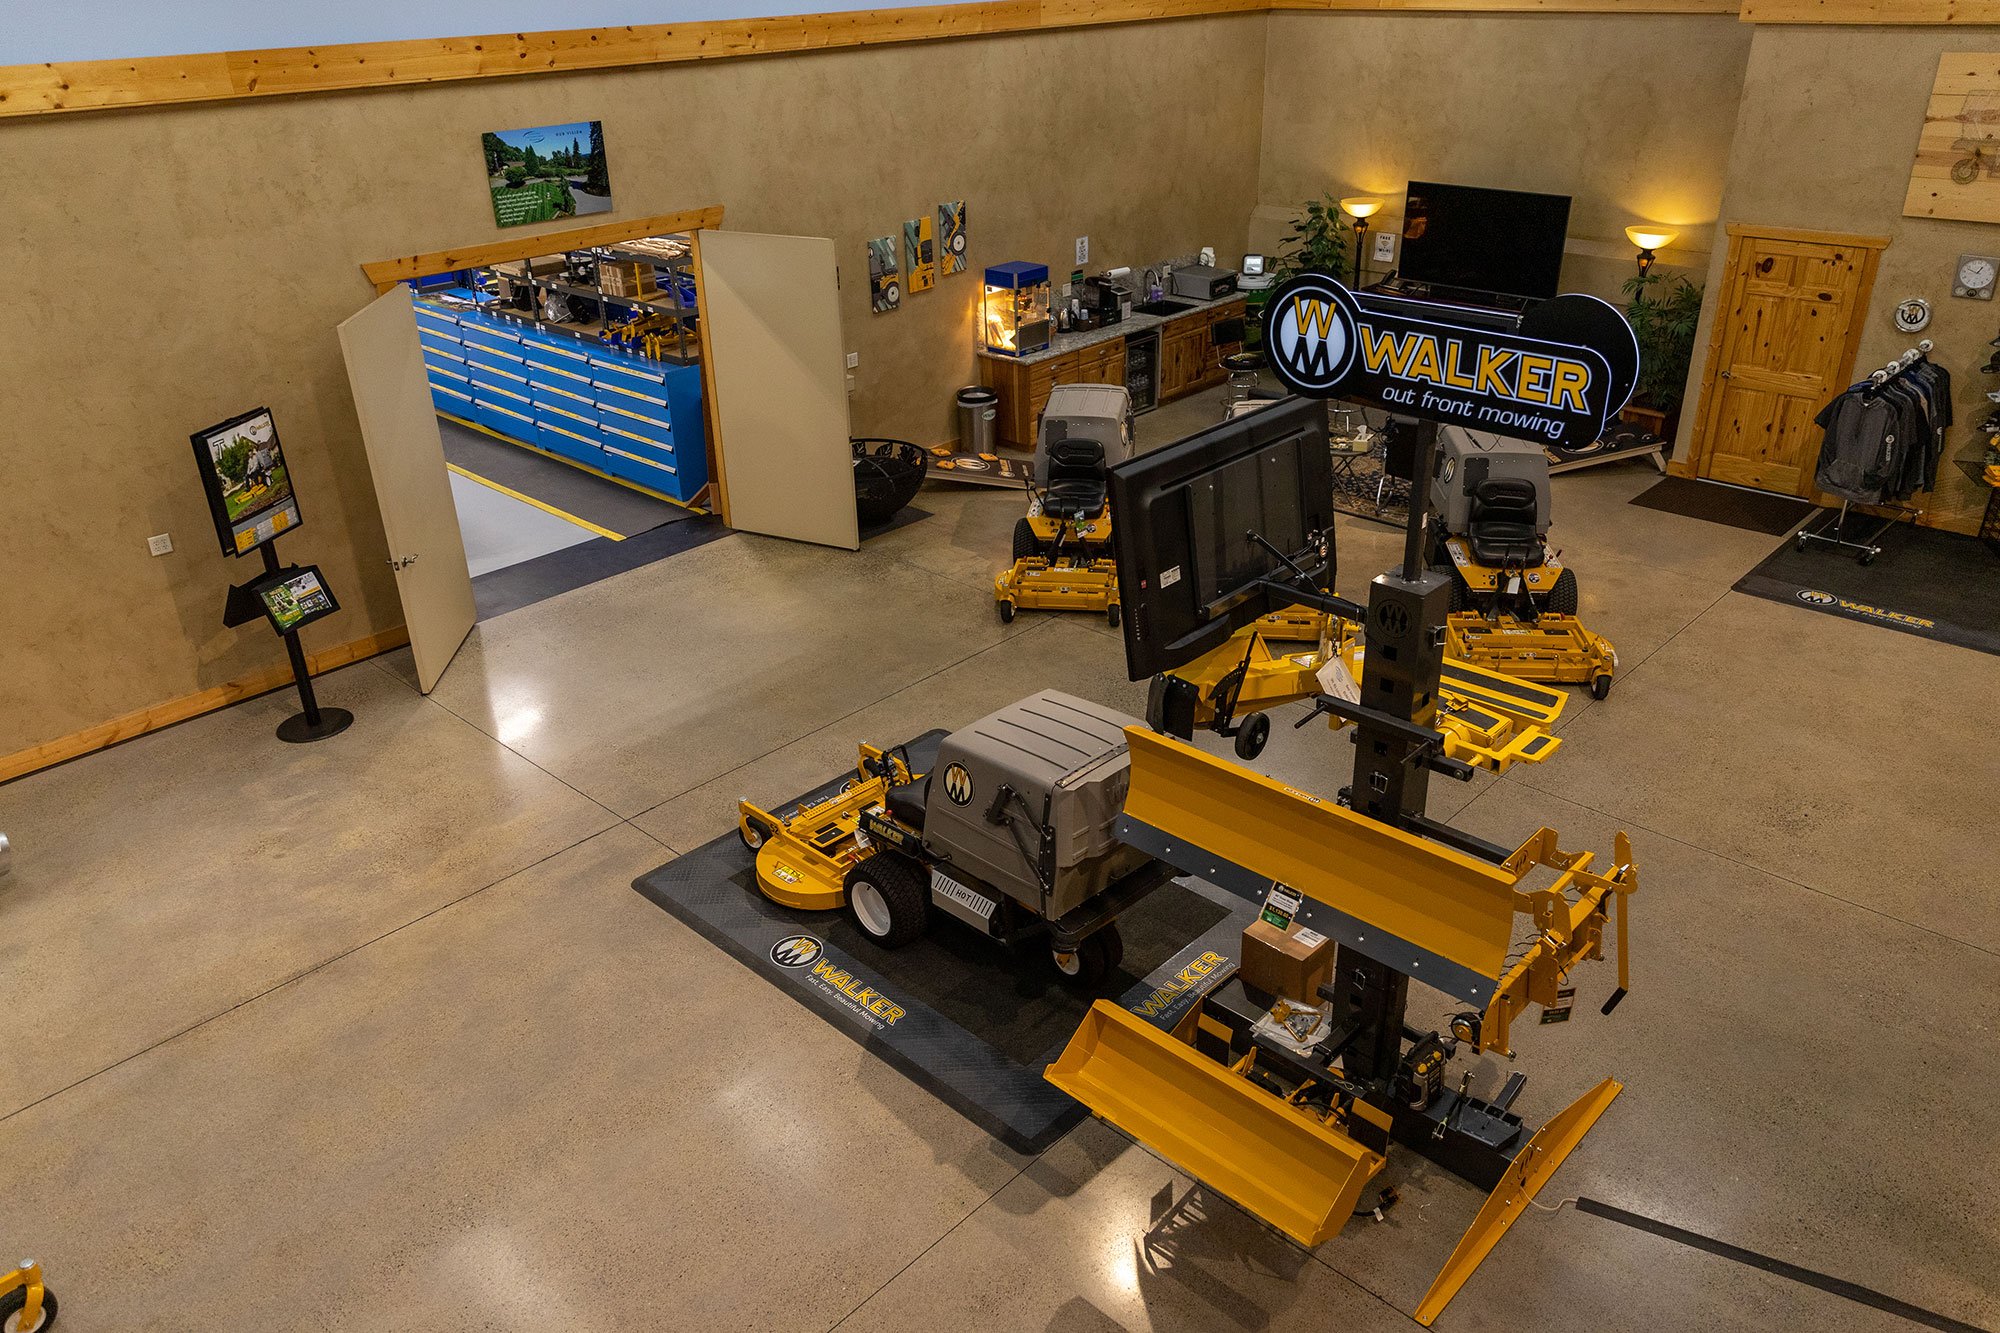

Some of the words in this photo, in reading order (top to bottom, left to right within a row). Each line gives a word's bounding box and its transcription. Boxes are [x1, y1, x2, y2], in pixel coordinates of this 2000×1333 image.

[1357, 322, 1593, 416] WALKER
[1382, 385, 1414, 404] out
[1421, 390, 1474, 418] front
[1480, 406, 1565, 439] mowing
[1839, 600, 1935, 628] WALKER
[869, 819, 904, 845] WALKER
[956, 889, 972, 902] HOT
[812, 957, 906, 1026] WALKER
[1129, 951, 1229, 1017] WALKER
[1189, 977, 1213, 999] Beautiful
[1211, 962, 1236, 981] Mowing
[833, 993, 860, 1013] Beautiful
[860, 1010, 885, 1030] Mowing
